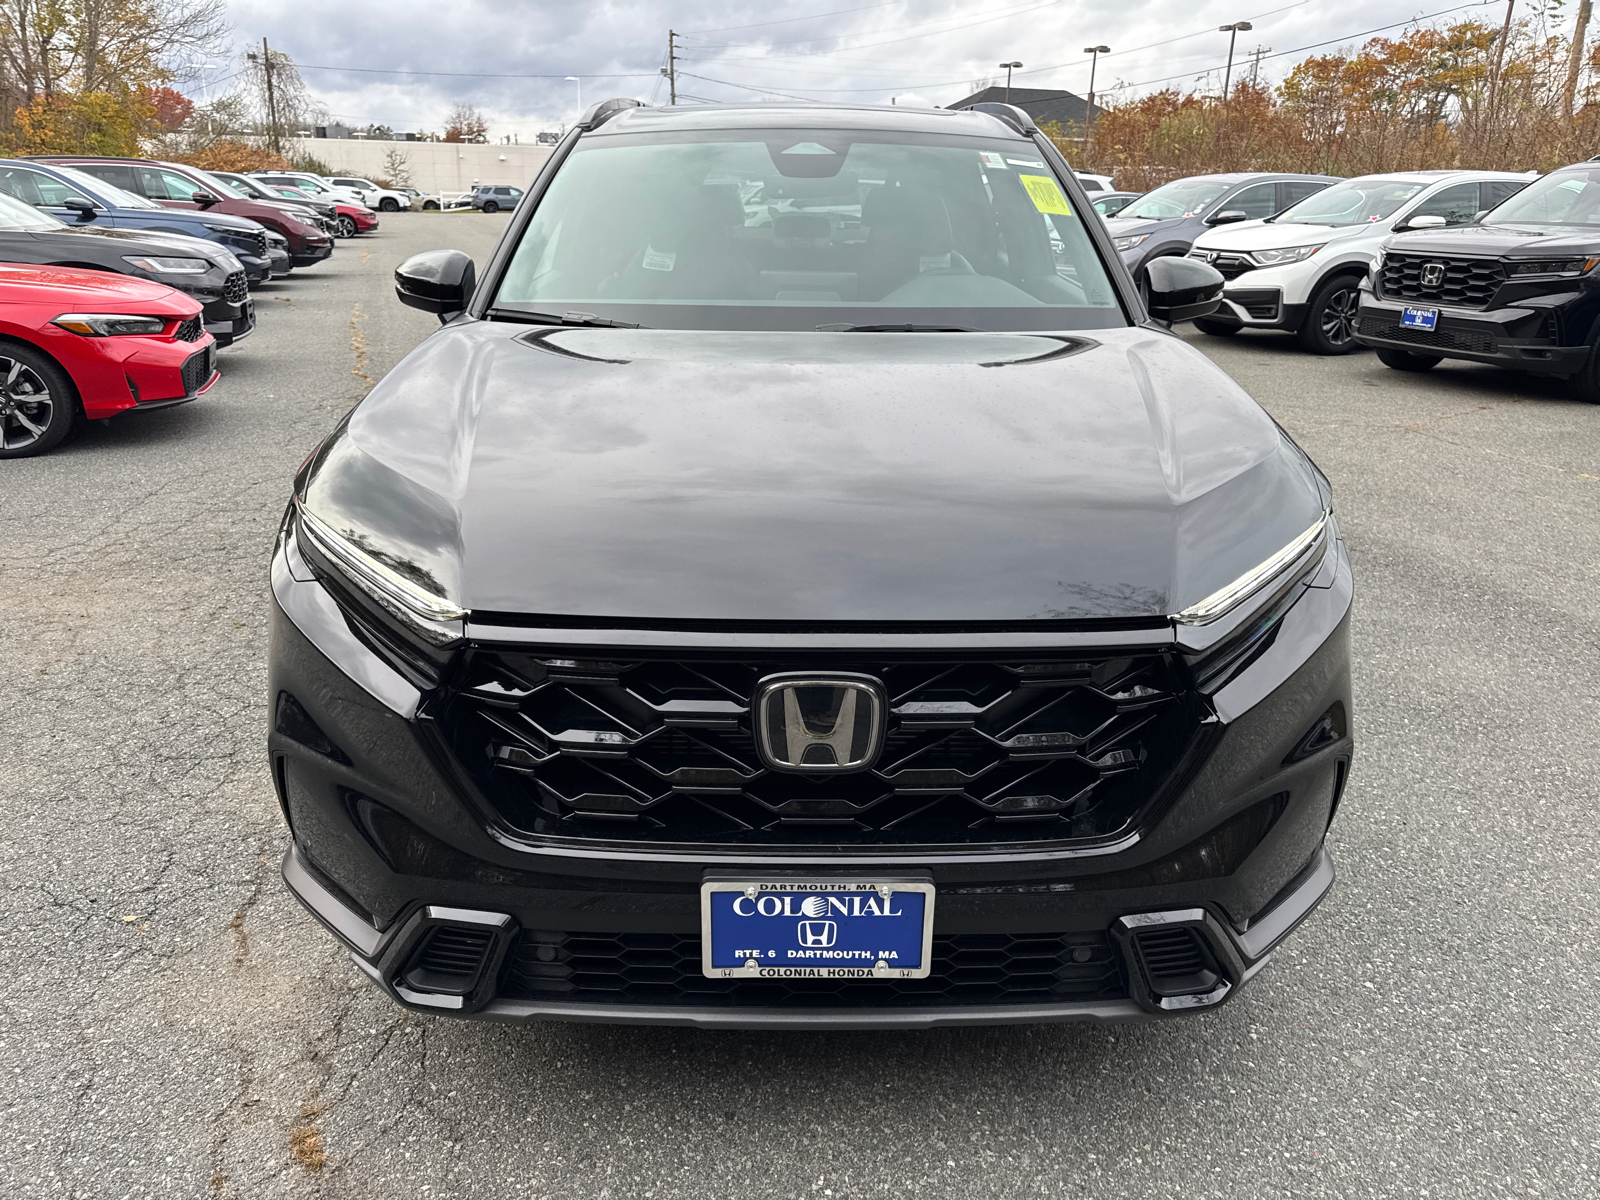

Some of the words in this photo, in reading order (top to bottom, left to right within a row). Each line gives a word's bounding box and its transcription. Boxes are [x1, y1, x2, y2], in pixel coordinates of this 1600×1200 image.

[733, 896, 902, 918] COLONIAL
[735, 950, 764, 958] RTE.
[768, 950, 776, 958] 6
[787, 950, 875, 960] DARTMOUTH,
[878, 951, 898, 959] MA
[759, 969, 824, 977] COLONIAL
[827, 969, 874, 977] HONDA
